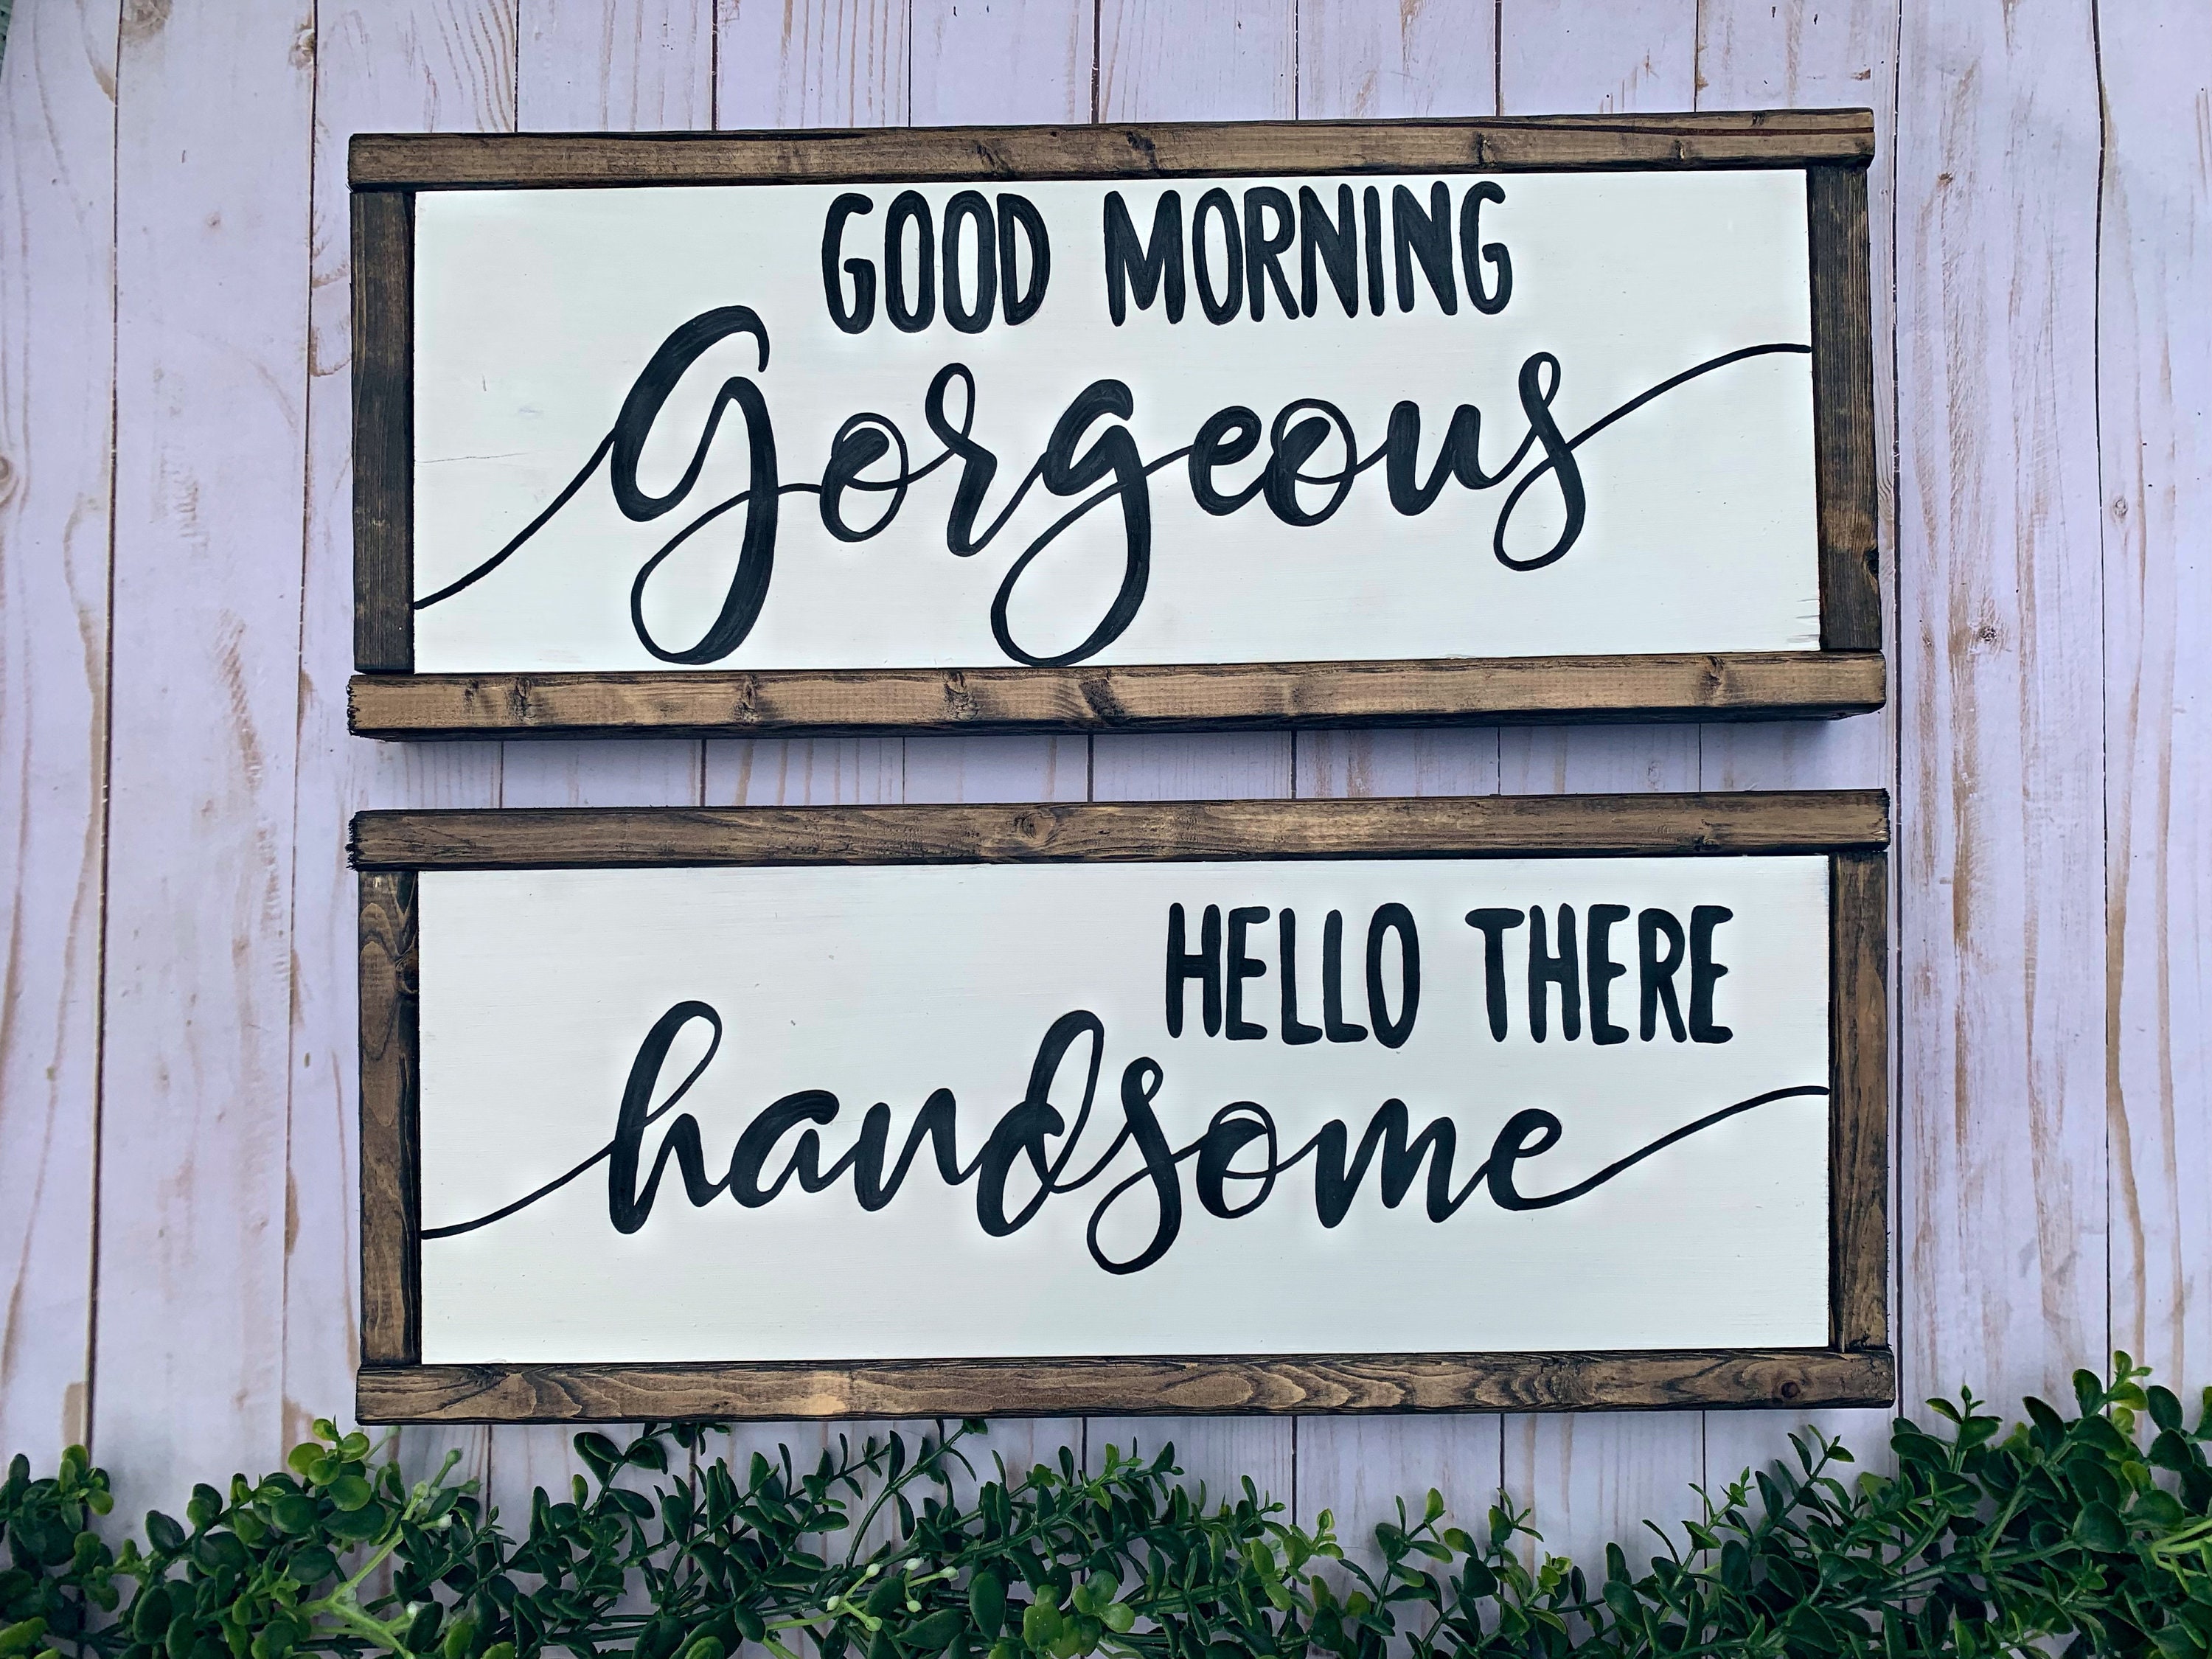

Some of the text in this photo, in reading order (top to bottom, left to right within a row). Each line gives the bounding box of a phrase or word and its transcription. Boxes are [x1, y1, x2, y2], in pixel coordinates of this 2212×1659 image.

[821, 180, 1513, 335] GOOD MORNING
[1165, 902, 1733, 1049] HELLO THERE
[422, 1000, 1829, 1276] handsome
